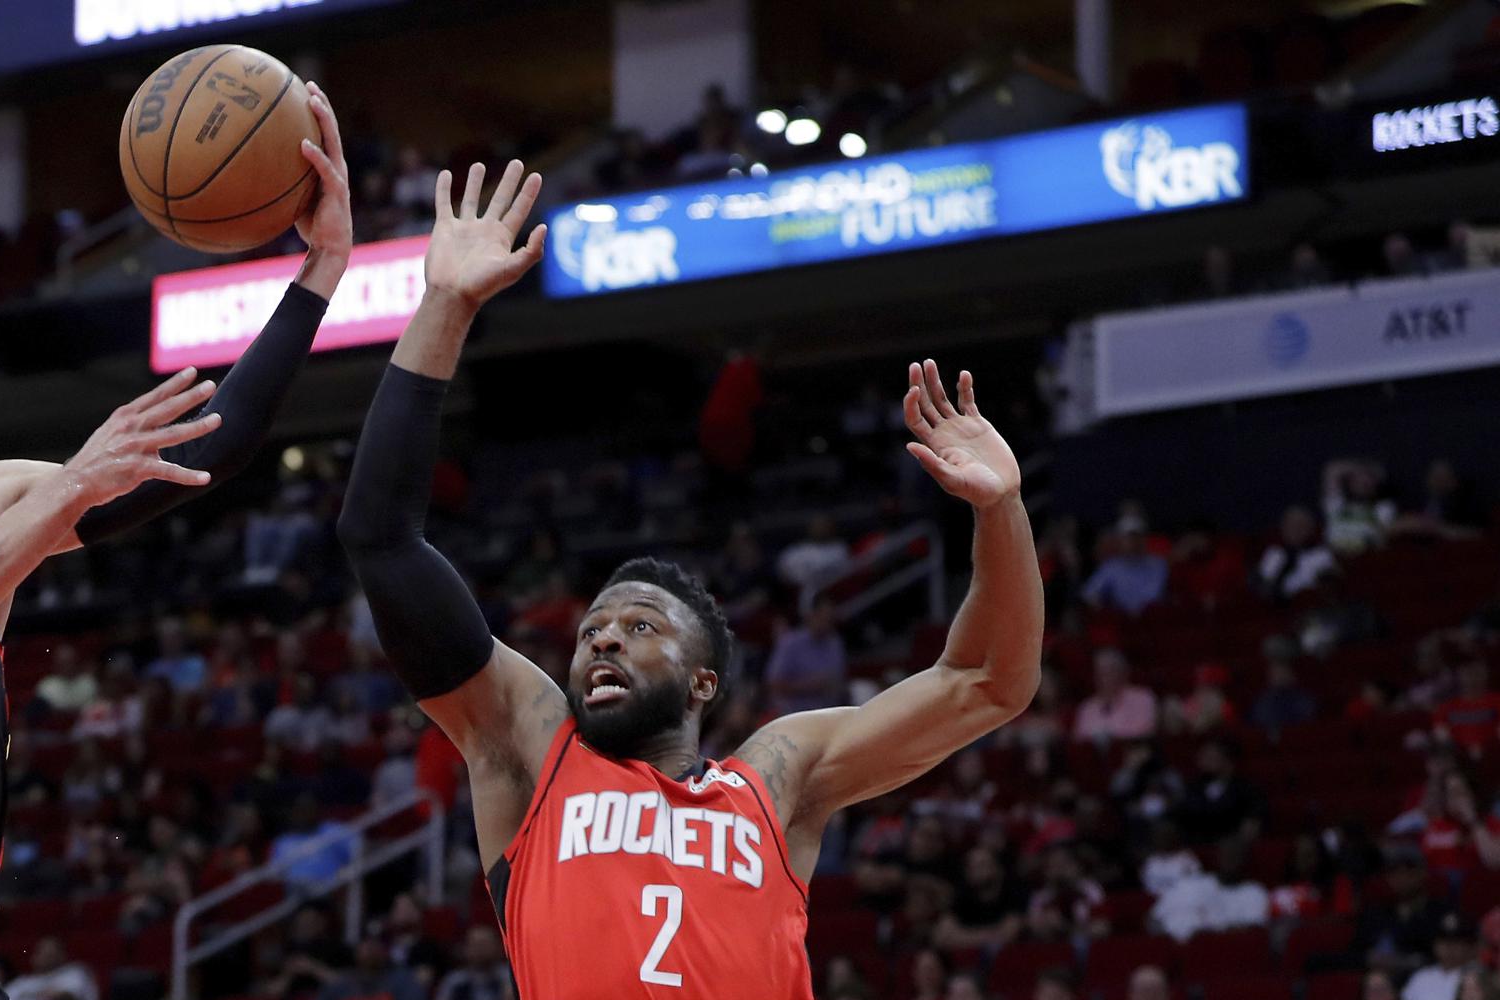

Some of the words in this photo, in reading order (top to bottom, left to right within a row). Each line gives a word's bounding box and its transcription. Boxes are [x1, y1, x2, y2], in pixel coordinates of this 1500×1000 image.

[1371, 96, 1500, 153] ROCKETS
[1135, 141, 1244, 211] KBR
[840, 184, 998, 248] FUTURE
[1386, 303, 1473, 346] AT&T
[557, 790, 763, 889] ROCKETS
[639, 884, 683, 987] 2
